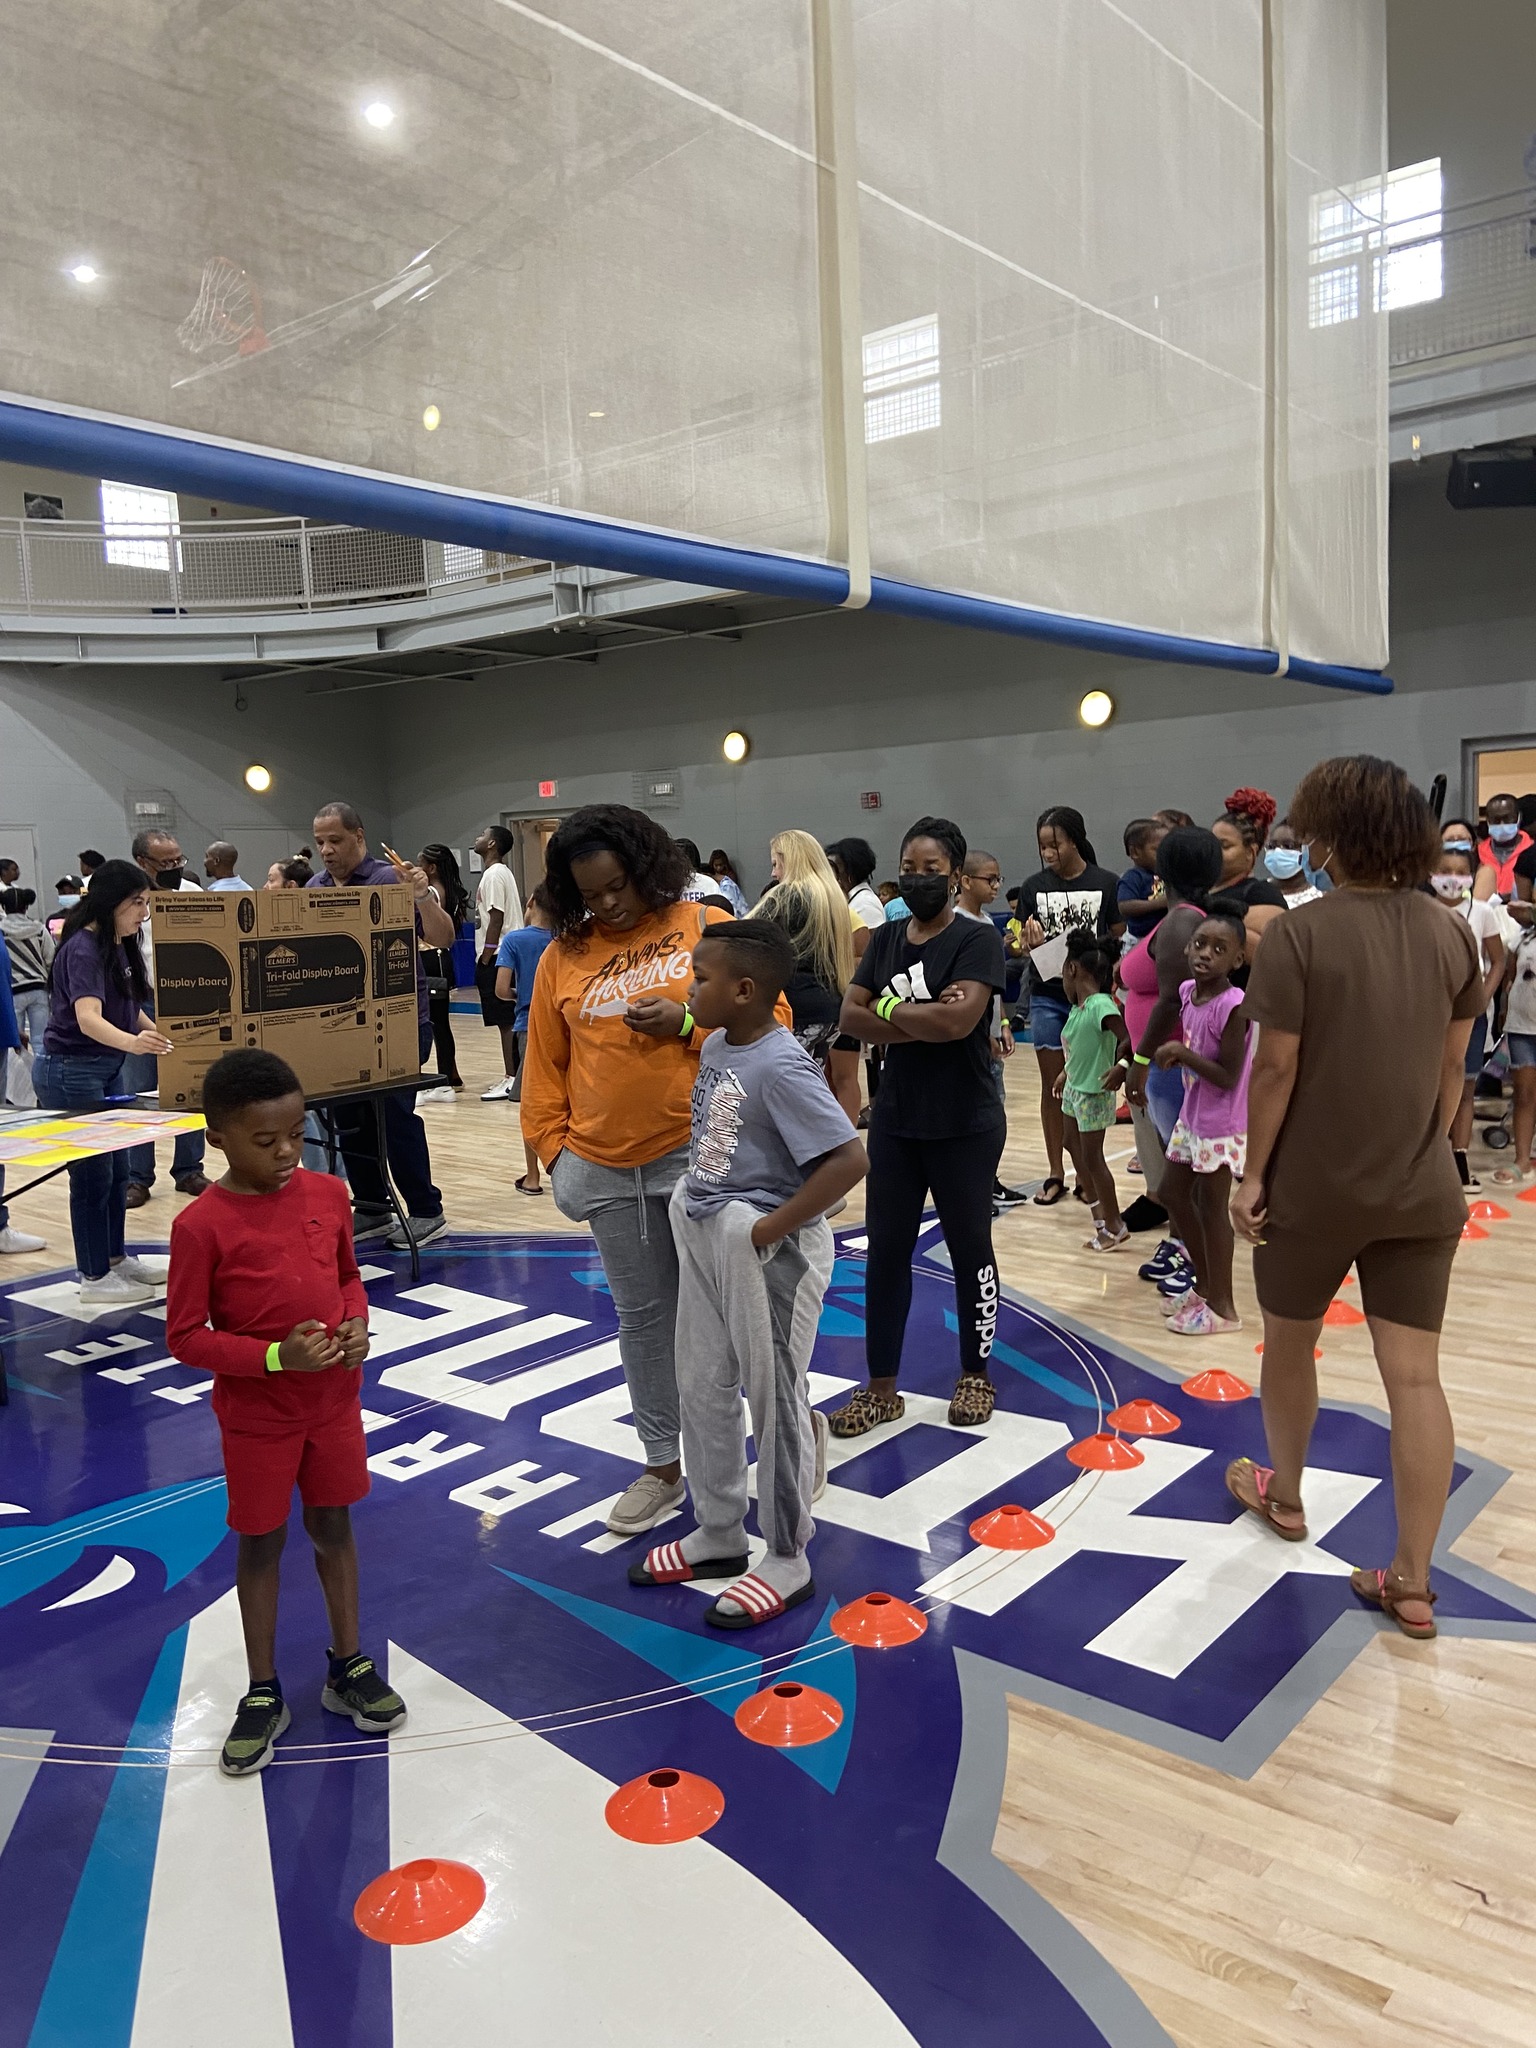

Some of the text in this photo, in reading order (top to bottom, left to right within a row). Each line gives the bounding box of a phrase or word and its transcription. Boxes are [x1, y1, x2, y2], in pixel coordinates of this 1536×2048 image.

[267, 956, 296, 965] ELMER'S
[388, 960, 409, 970] Tri-Fold
[577, 929, 685, 1002] ALWAYS
[266, 964, 359, 982] Tri-Fold Display Board
[160, 977, 228, 989] Display Board
[975, 1264, 998, 1359] adidas
